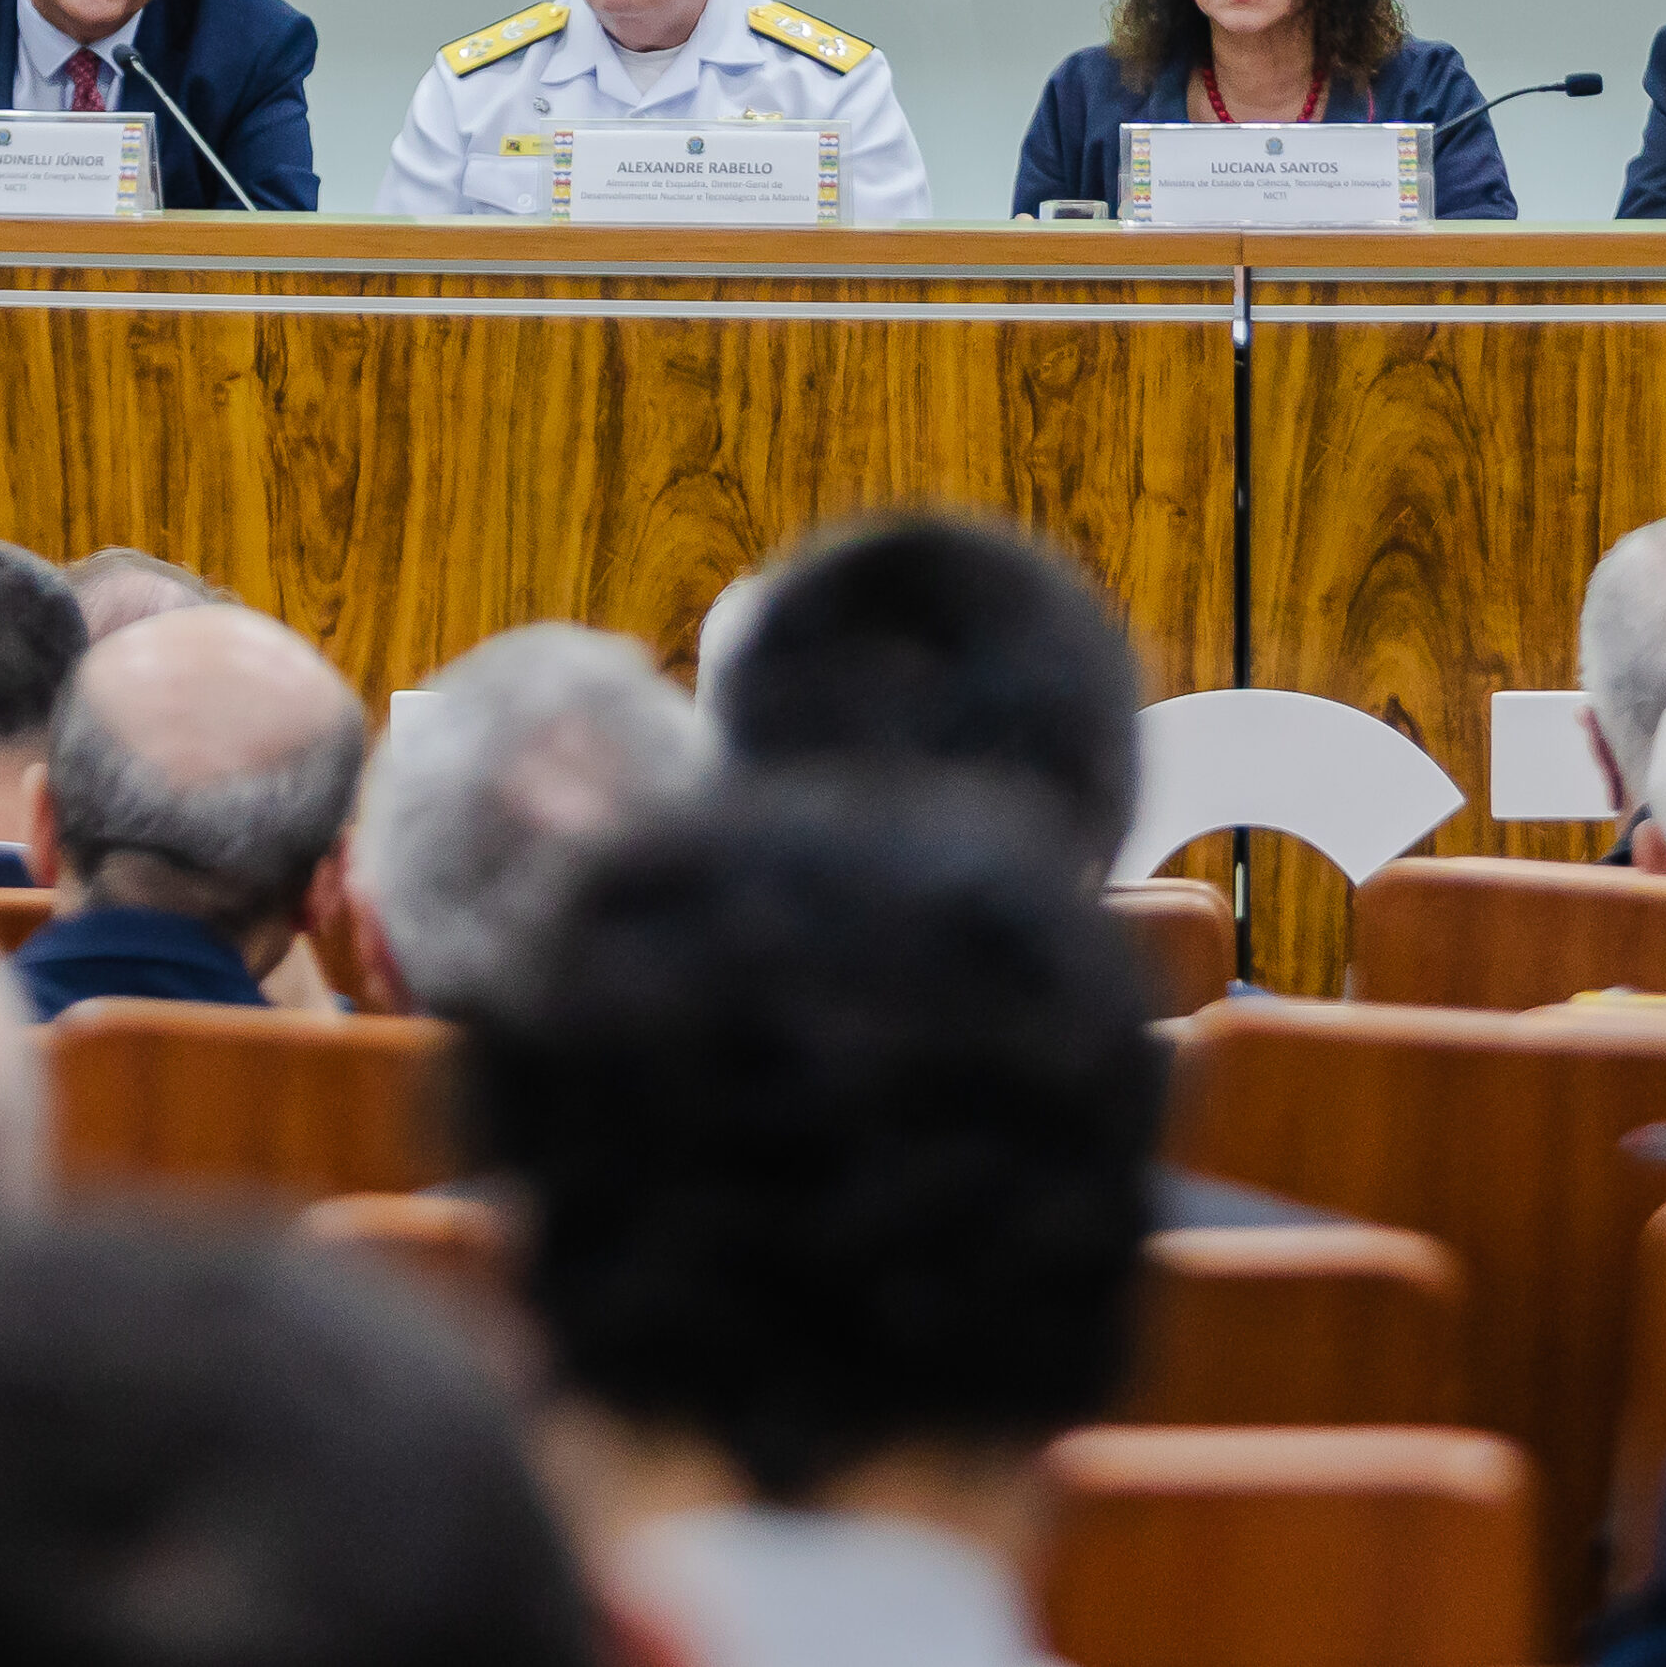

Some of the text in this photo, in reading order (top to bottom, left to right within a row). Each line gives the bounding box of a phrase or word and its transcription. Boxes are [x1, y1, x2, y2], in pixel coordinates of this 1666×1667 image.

[55, 152, 105, 167] JÚNIOR
[617, 161, 773, 175] ALEXANDRE RABELLO
[1211, 161, 1338, 174] LUCIANA SANTOS
[652, 179, 663, 188] de
[772, 179, 783, 189] de
[1158, 179, 1195, 187] Ministra
[1197, 178, 1209, 187] de
[1211, 178, 1241, 187] Estado
[1243, 178, 1255, 187] da
